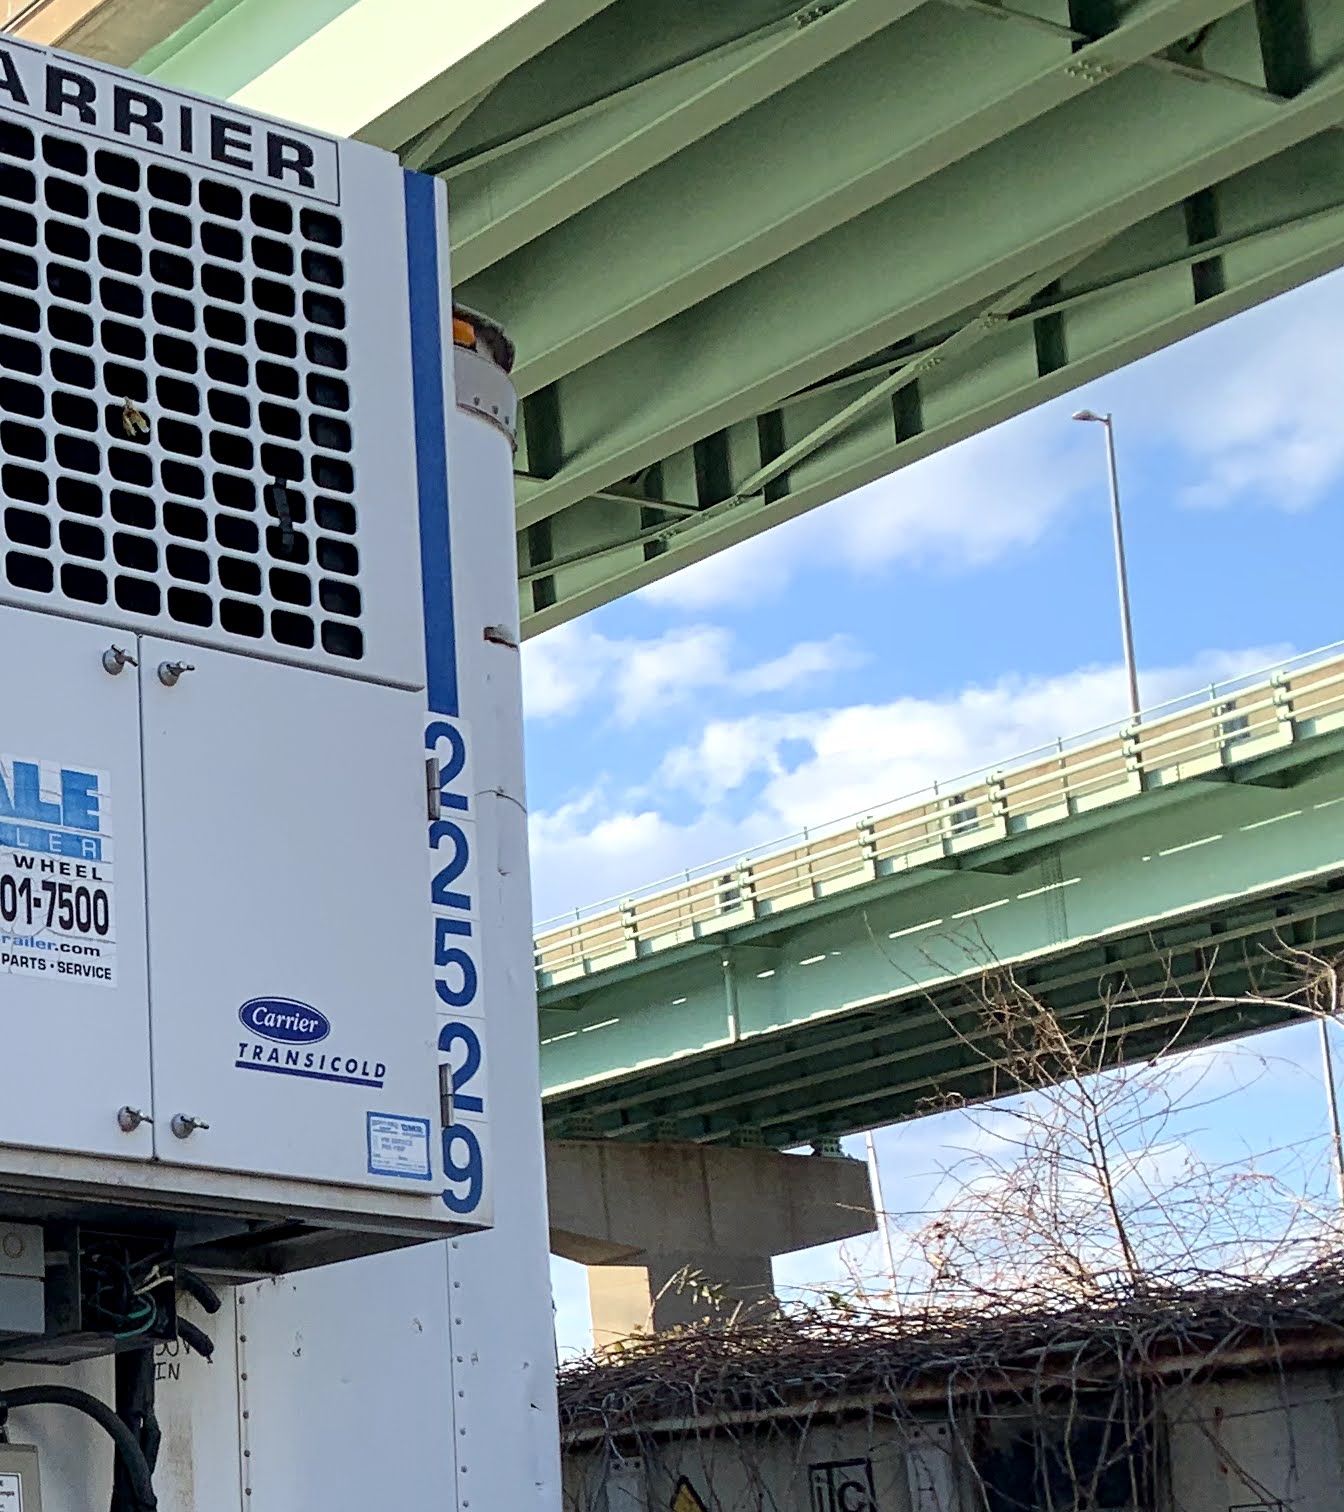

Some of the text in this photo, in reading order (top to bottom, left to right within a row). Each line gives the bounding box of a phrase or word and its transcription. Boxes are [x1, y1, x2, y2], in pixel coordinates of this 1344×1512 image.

[13, 854, 102, 881] WHEEL
[1, 952, 47, 971] PARTS
[57, 961, 112, 980] SERVICE
[424, 721, 484, 1214] 22529
[252, 1006, 319, 1033] Carrier
[239, 1042, 387, 1078] TRANSICOLD
[155, 1362, 180, 1381] IN
